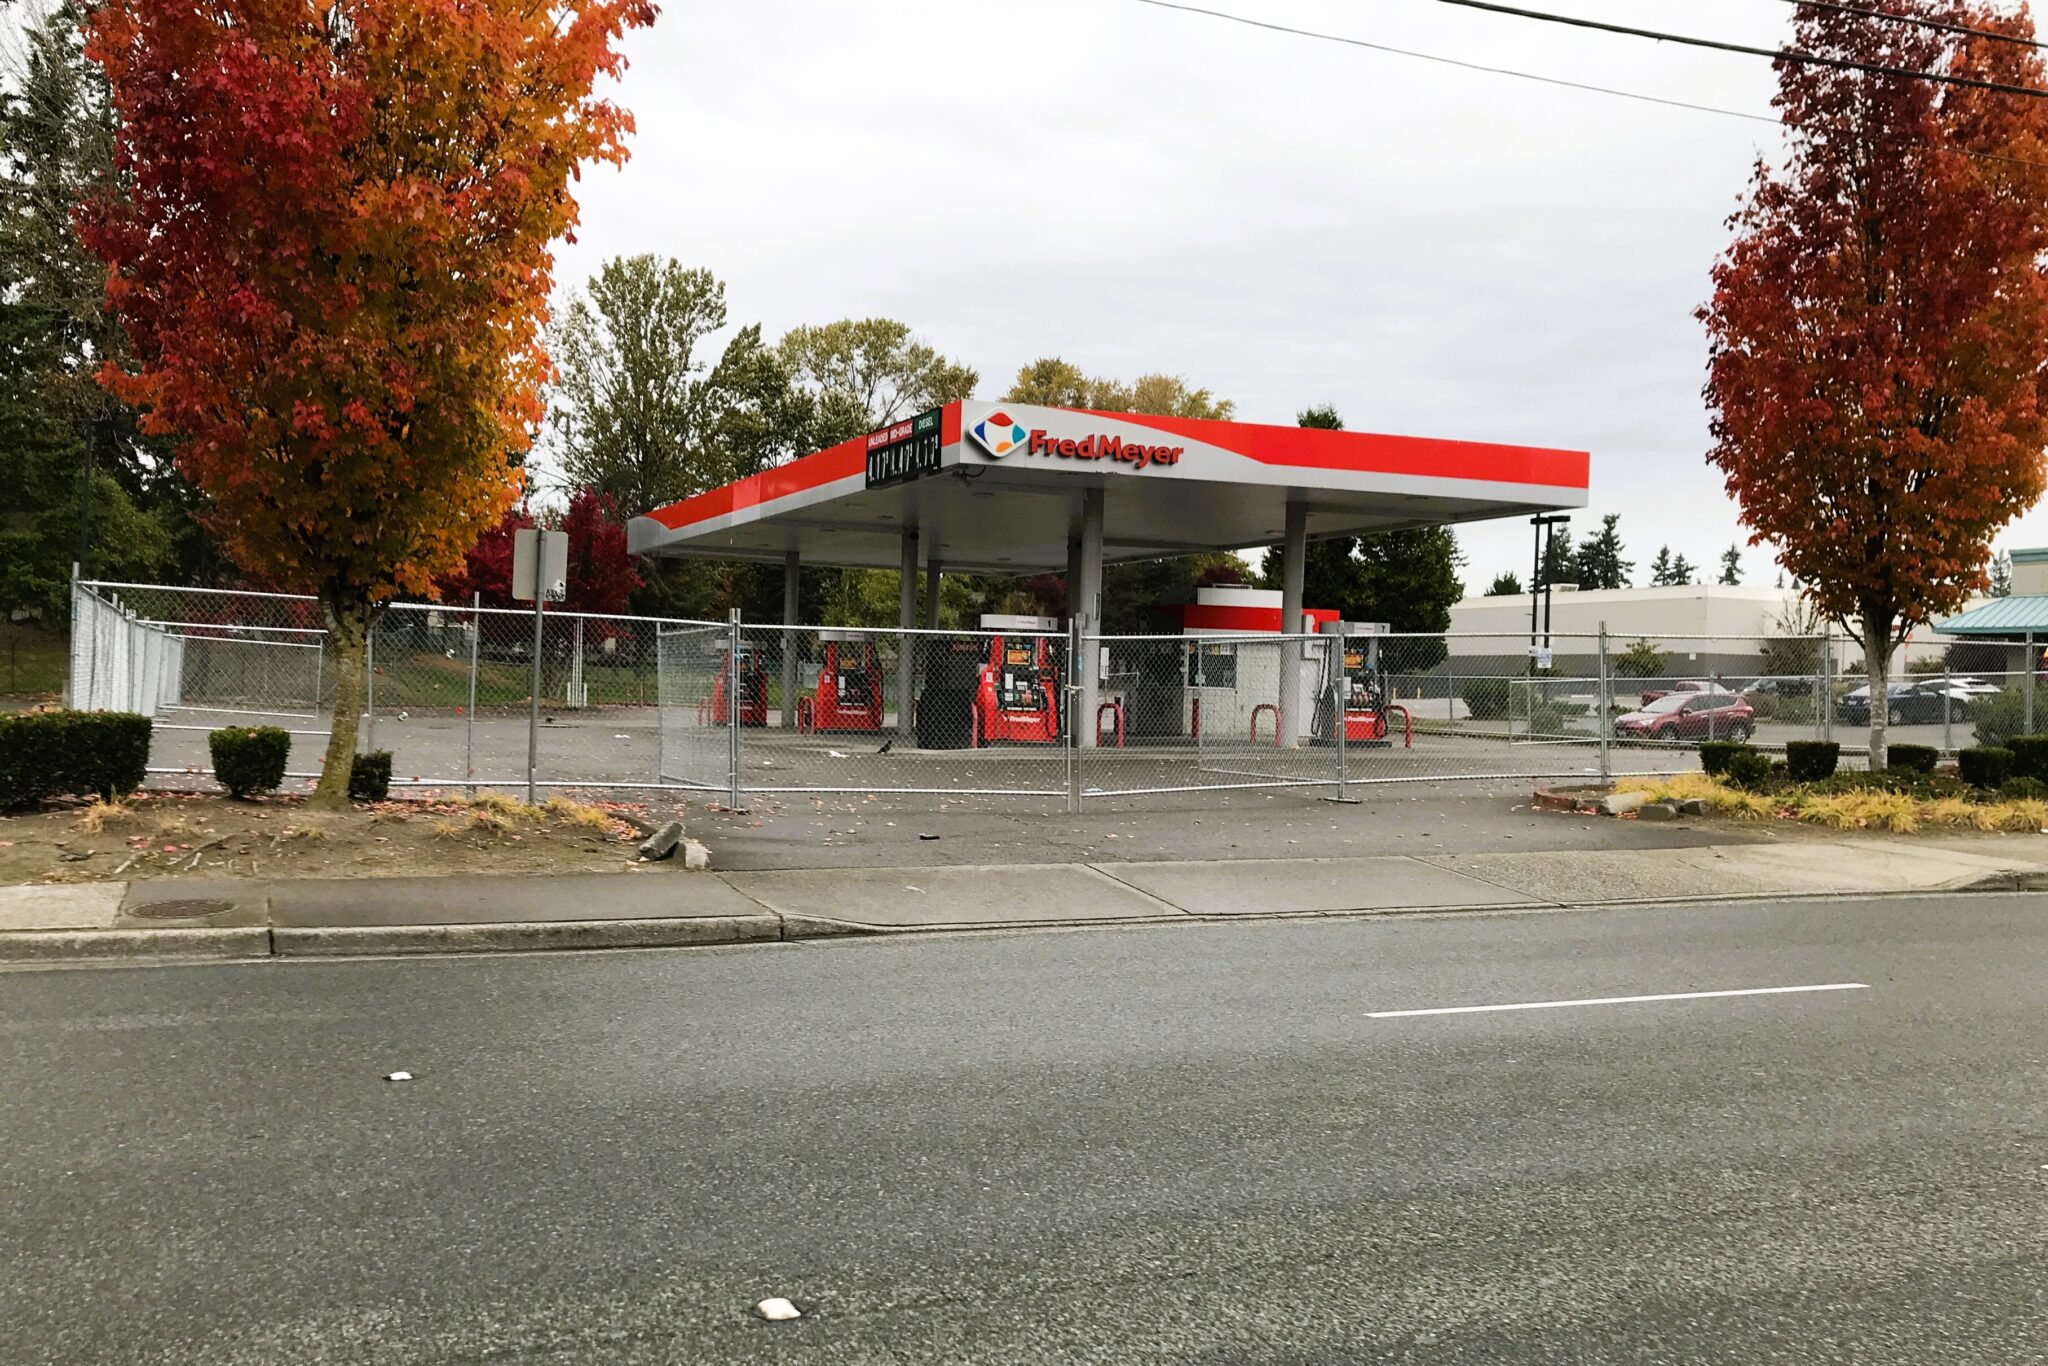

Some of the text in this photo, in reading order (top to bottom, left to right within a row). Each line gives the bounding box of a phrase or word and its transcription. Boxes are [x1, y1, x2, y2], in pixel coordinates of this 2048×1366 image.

[890, 422, 913, 440] MID-GRADE
[918, 416, 934, 430] DIESEL
[868, 431, 889, 448] UNLEADED
